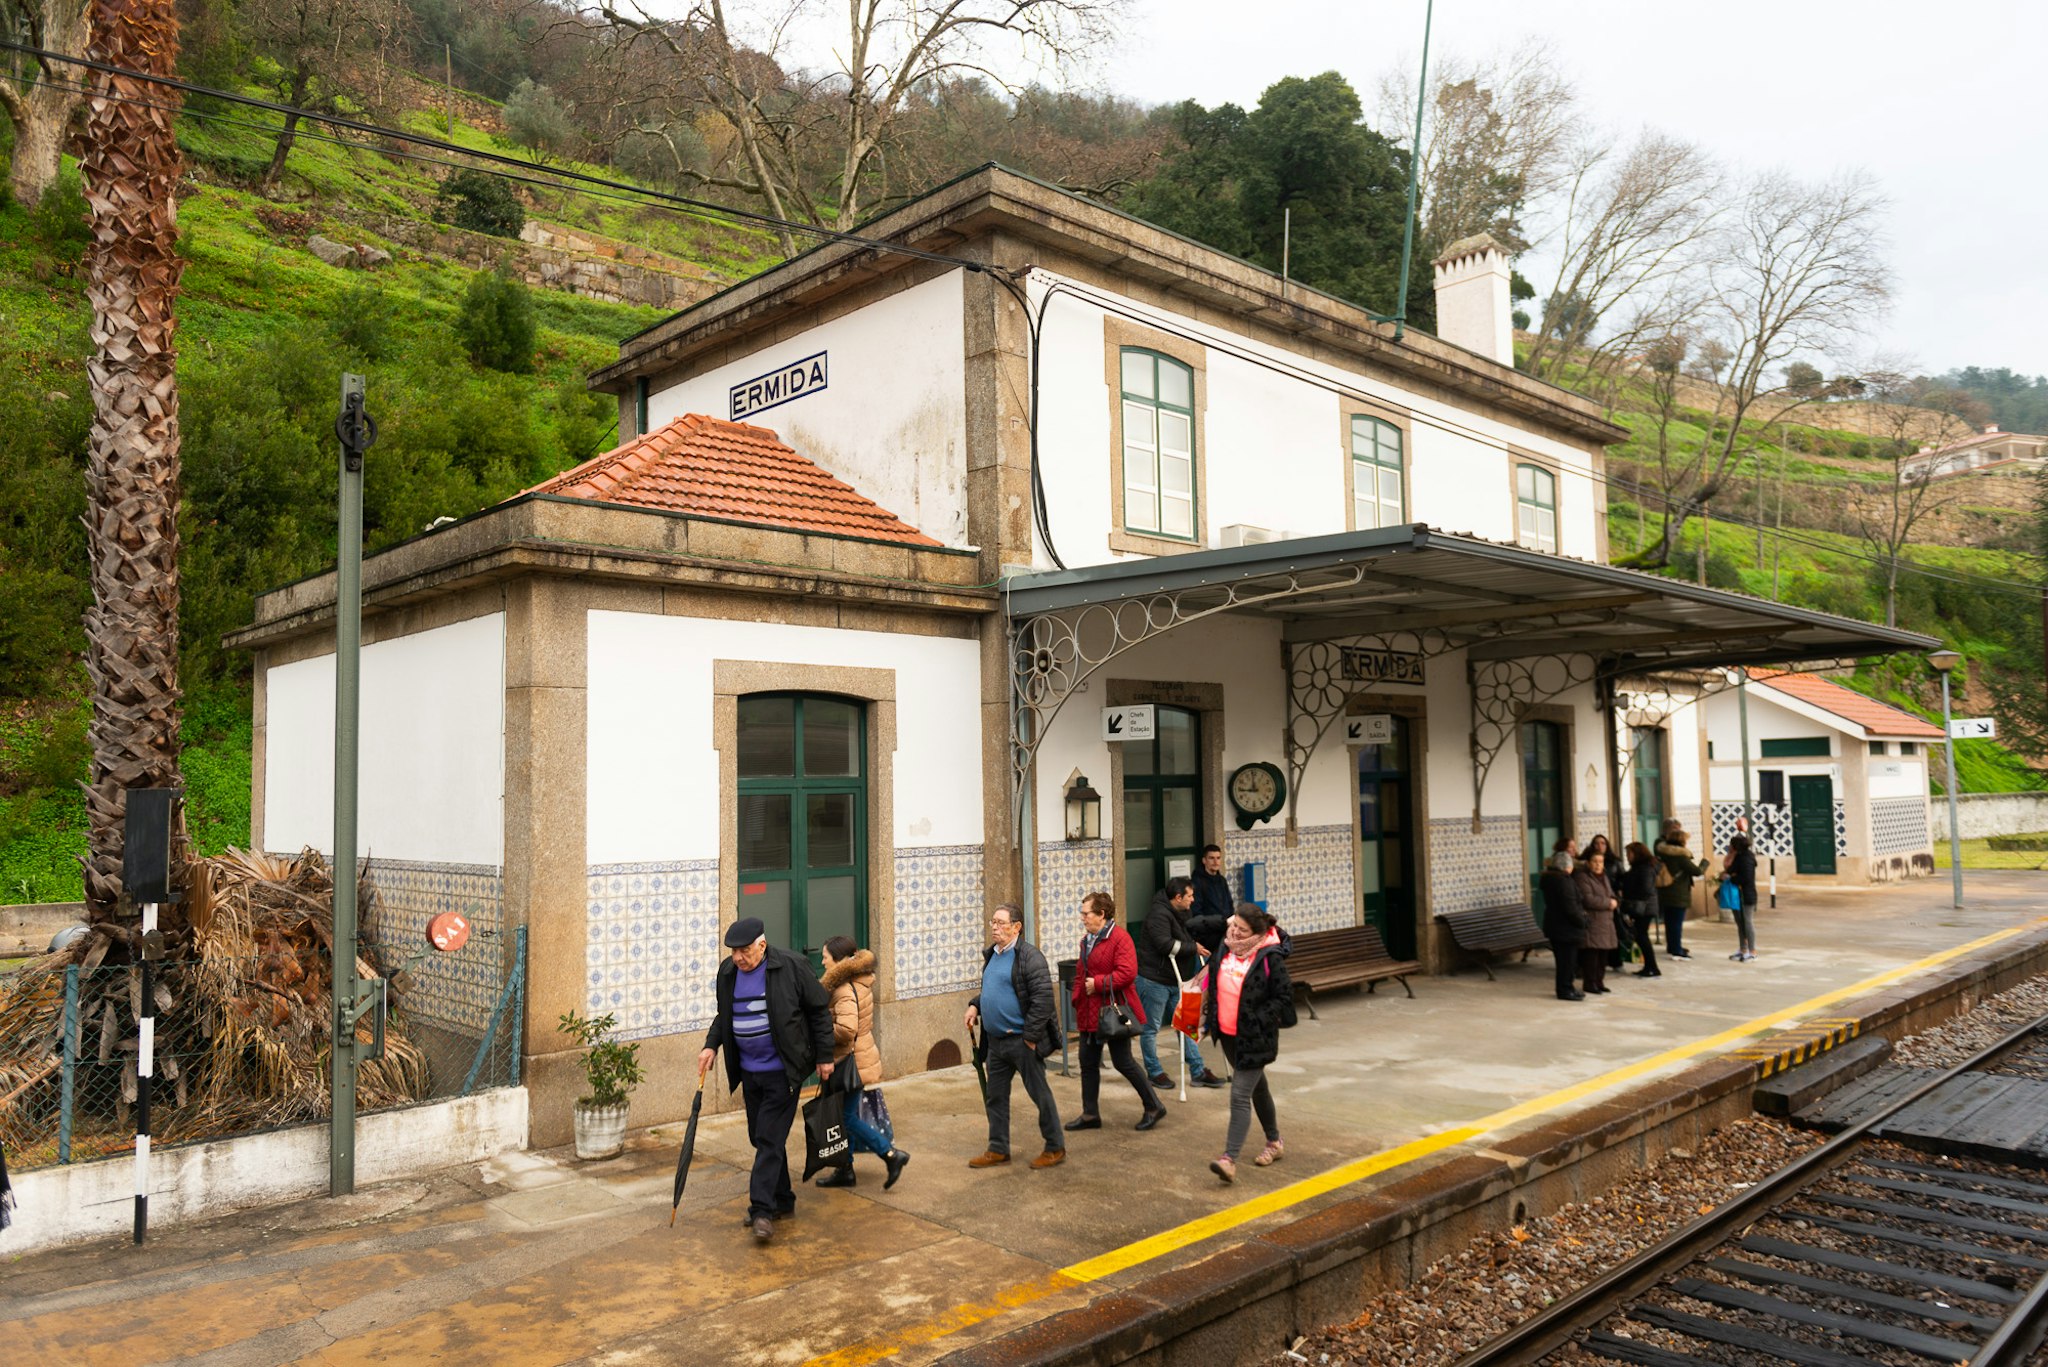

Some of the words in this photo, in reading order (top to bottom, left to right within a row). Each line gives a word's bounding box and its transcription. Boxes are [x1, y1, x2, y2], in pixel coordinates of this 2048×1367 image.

[733, 361, 824, 415] ERMIDA
[1960, 726, 1965, 736] 1
[819, 1139, 848, 1158] SEASIDE
